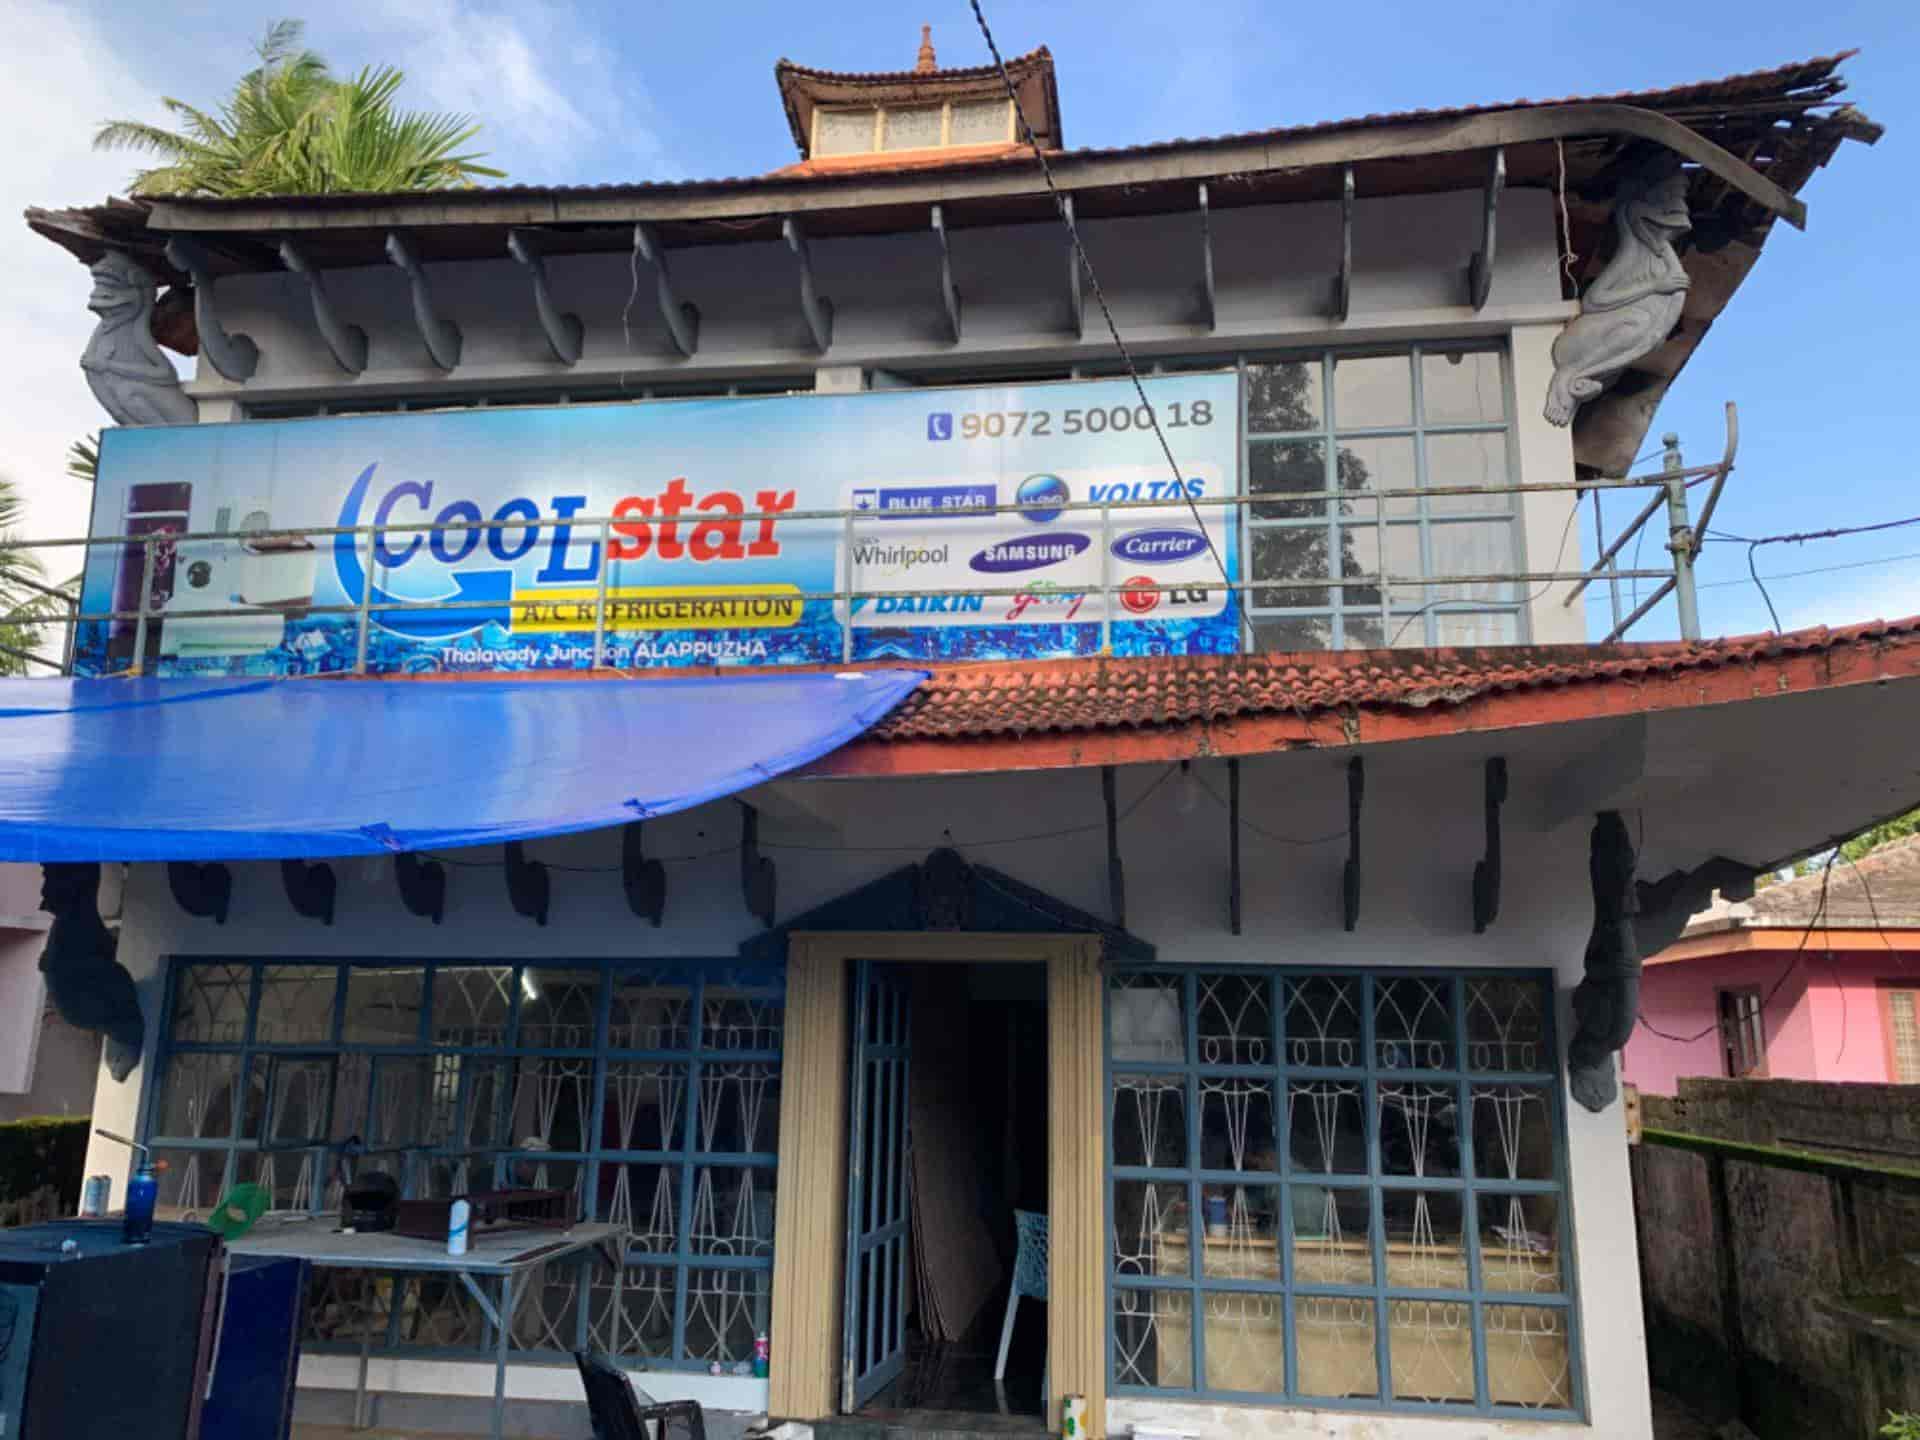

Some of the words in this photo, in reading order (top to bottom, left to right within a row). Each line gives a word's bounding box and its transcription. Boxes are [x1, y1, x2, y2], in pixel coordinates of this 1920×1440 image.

[961, 411, 1052, 438] 9072
[1063, 406, 1154, 434] 5000
[1166, 400, 1213, 428] 18
[1088, 478, 1205, 503] VOLTAS
[888, 495, 933, 512] BLUE
[941, 493, 986, 510] STAR
[608, 477, 796, 561] star
[984, 543, 1076, 563] SAMSUNG
[1125, 537, 1198, 553] Carrier
[852, 545, 948, 568] Whirlpool
[875, 594, 984, 614] DAIKIN
[634, 639, 767, 660] ALAPPUZHA
